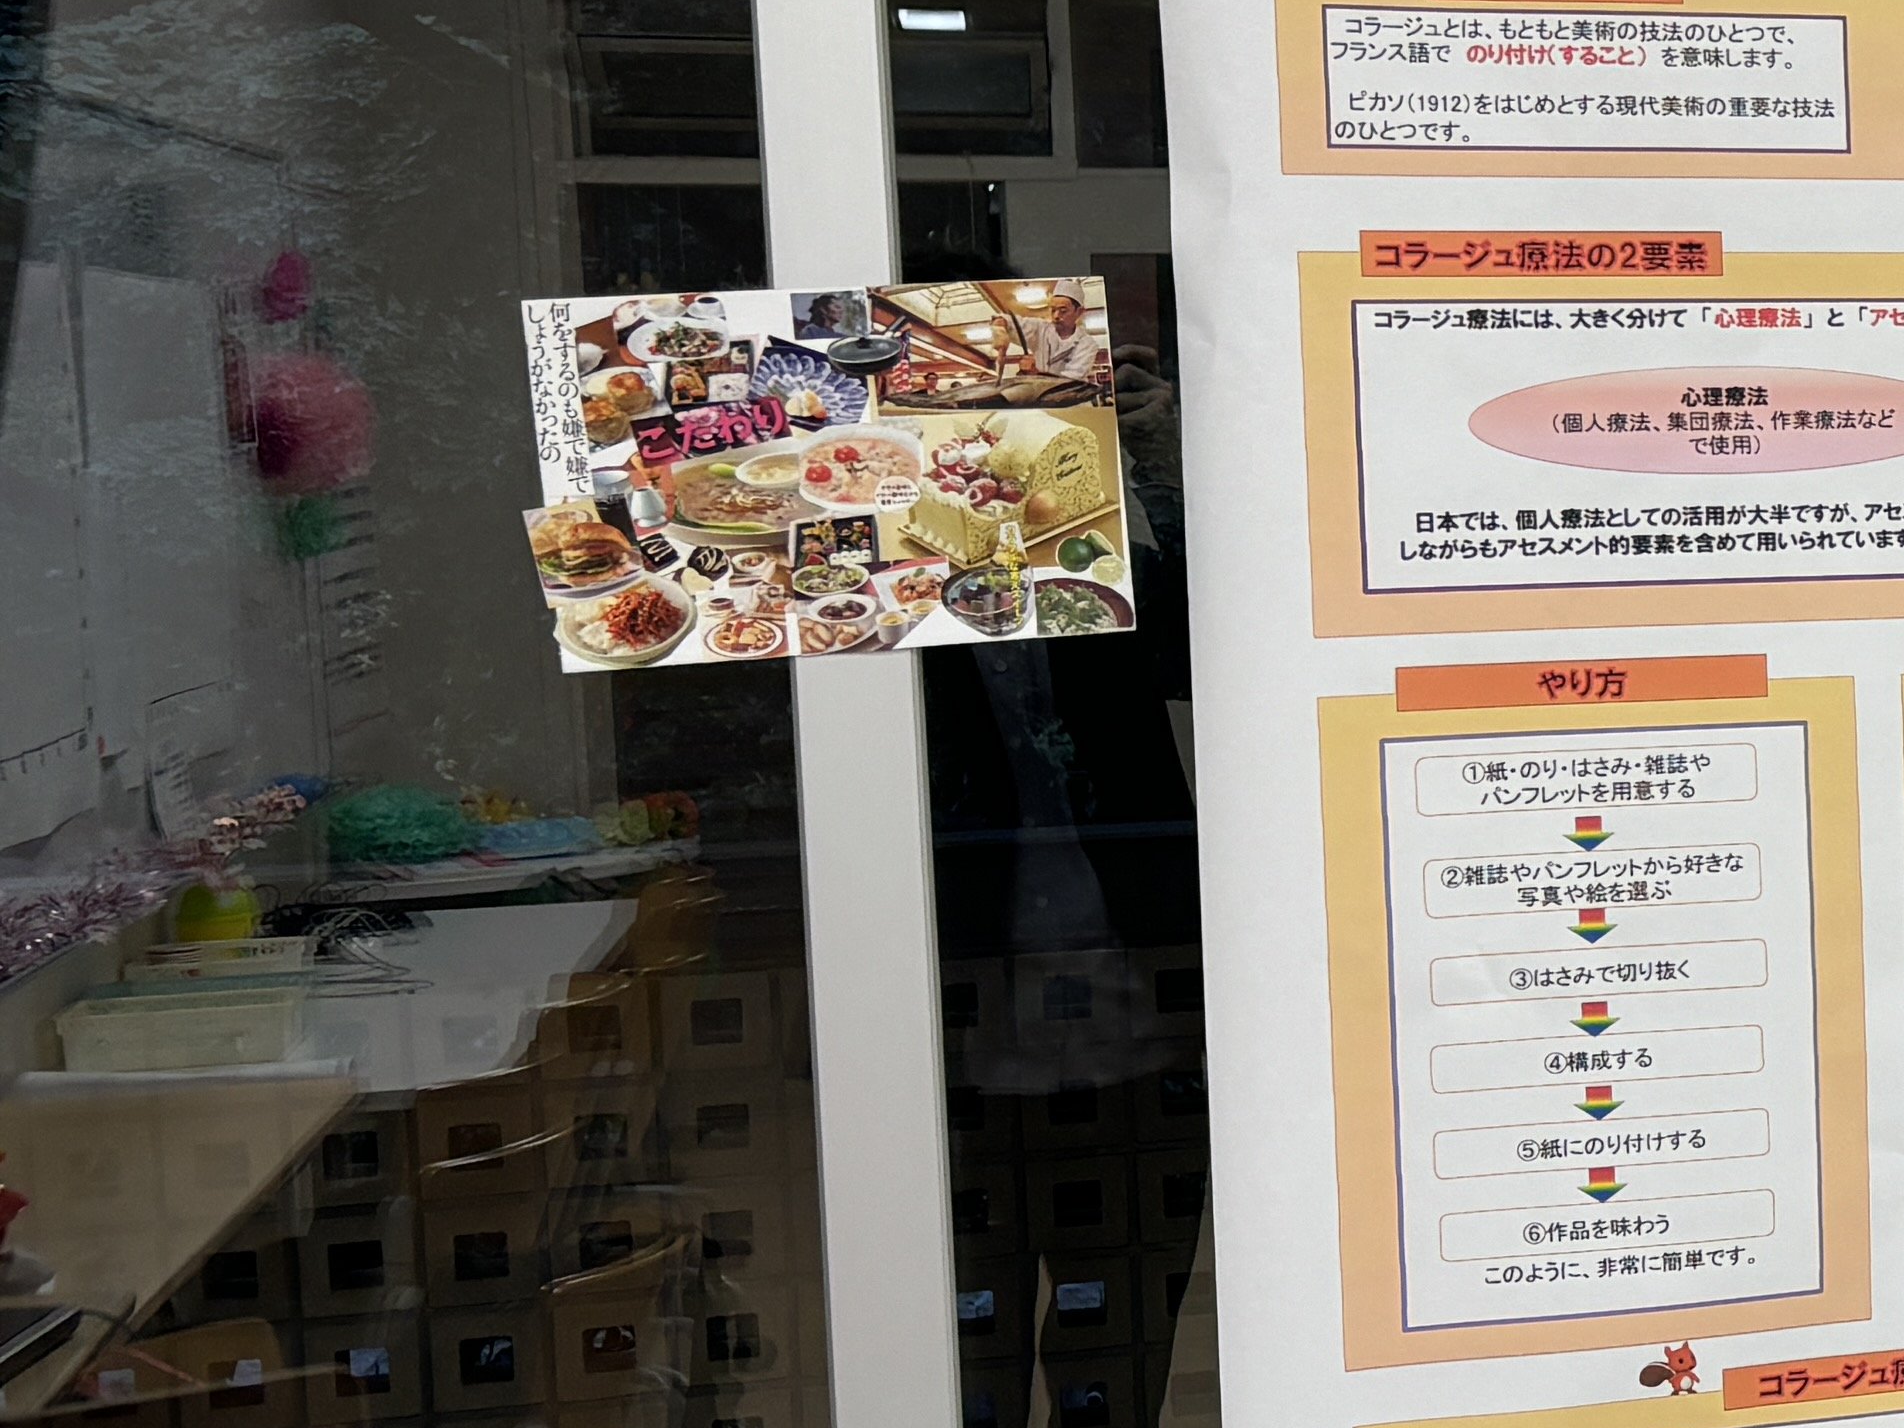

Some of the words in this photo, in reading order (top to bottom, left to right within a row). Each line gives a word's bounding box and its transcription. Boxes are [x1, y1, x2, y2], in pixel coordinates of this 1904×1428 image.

[1345, 17, 1795, 44] コラージュとは、もともと美術の技法のひとつで、
[1335, 121, 1472, 143] のひとつです。
[1375, 241, 1708, 270] コラージュ療法の2要素
[1681, 387, 1769, 407] 心理療法
[638, 396, 787, 459] こだわり
[1689, 435, 1762, 456] で使用）
[1538, 669, 1627, 701] やり方
[1481, 779, 1695, 807] パンフレットを用意する
[1517, 879, 1672, 908] 写真や絵を選ぶ
[1544, 1048, 1652, 1074] ④構成する
[1517, 1129, 1707, 1162] ⑤紙にのり付けする
[1523, 1215, 1669, 1244] ⑥作品を味わう
[1484, 1247, 1756, 1285] このように、非常に簡単です。
